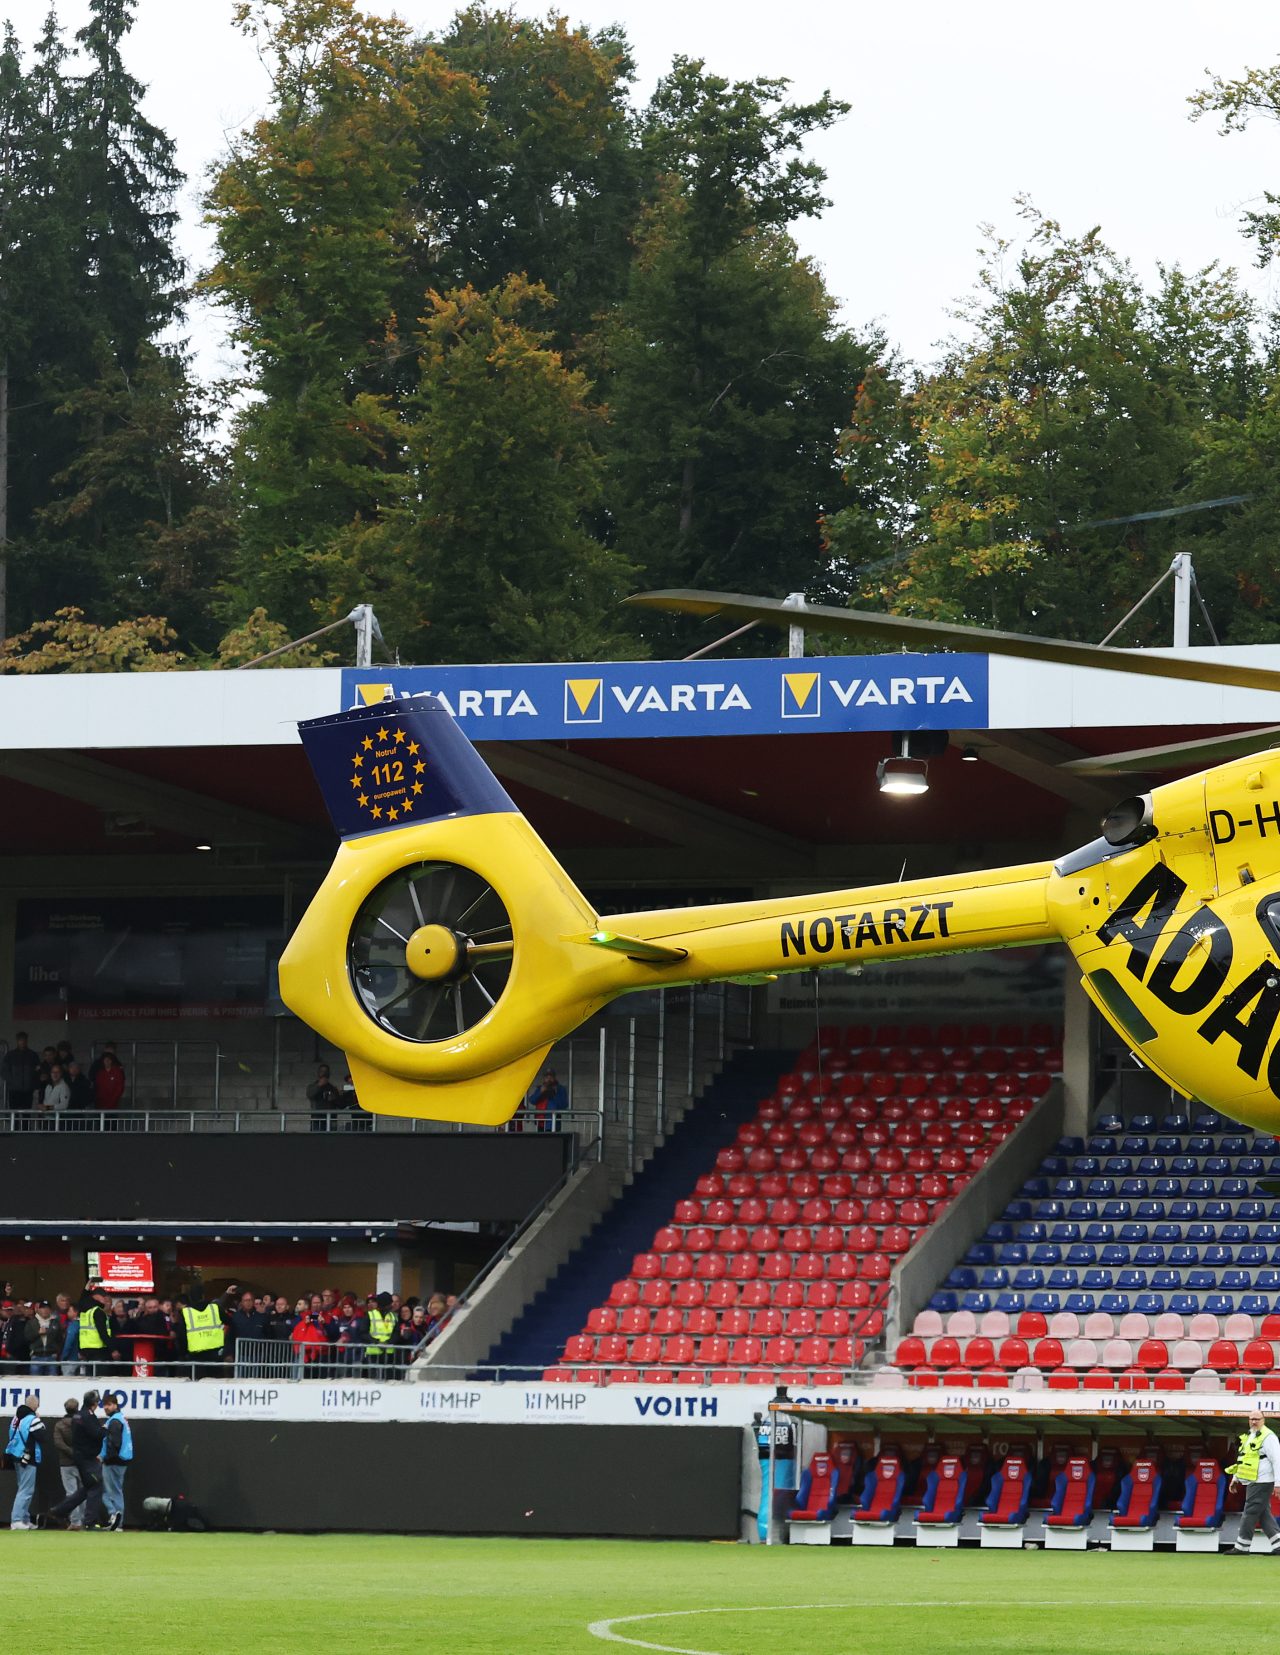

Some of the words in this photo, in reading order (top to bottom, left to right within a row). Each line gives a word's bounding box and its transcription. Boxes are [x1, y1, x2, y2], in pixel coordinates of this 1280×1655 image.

[611, 683, 751, 712] VARTA
[829, 676, 973, 705] VARTA
[375, 747, 397, 759] Notruf
[371, 761, 405, 785] 112
[373, 786, 407, 801] europaweit
[780, 901, 954, 957] NOTARZT
[239, 1389, 279, 1406] MHP
[341, 1390, 382, 1407] MHP
[440, 1392, 481, 1409] MHP
[545, 1393, 586, 1410] MHP
[634, 1396, 718, 1417] VOITH
